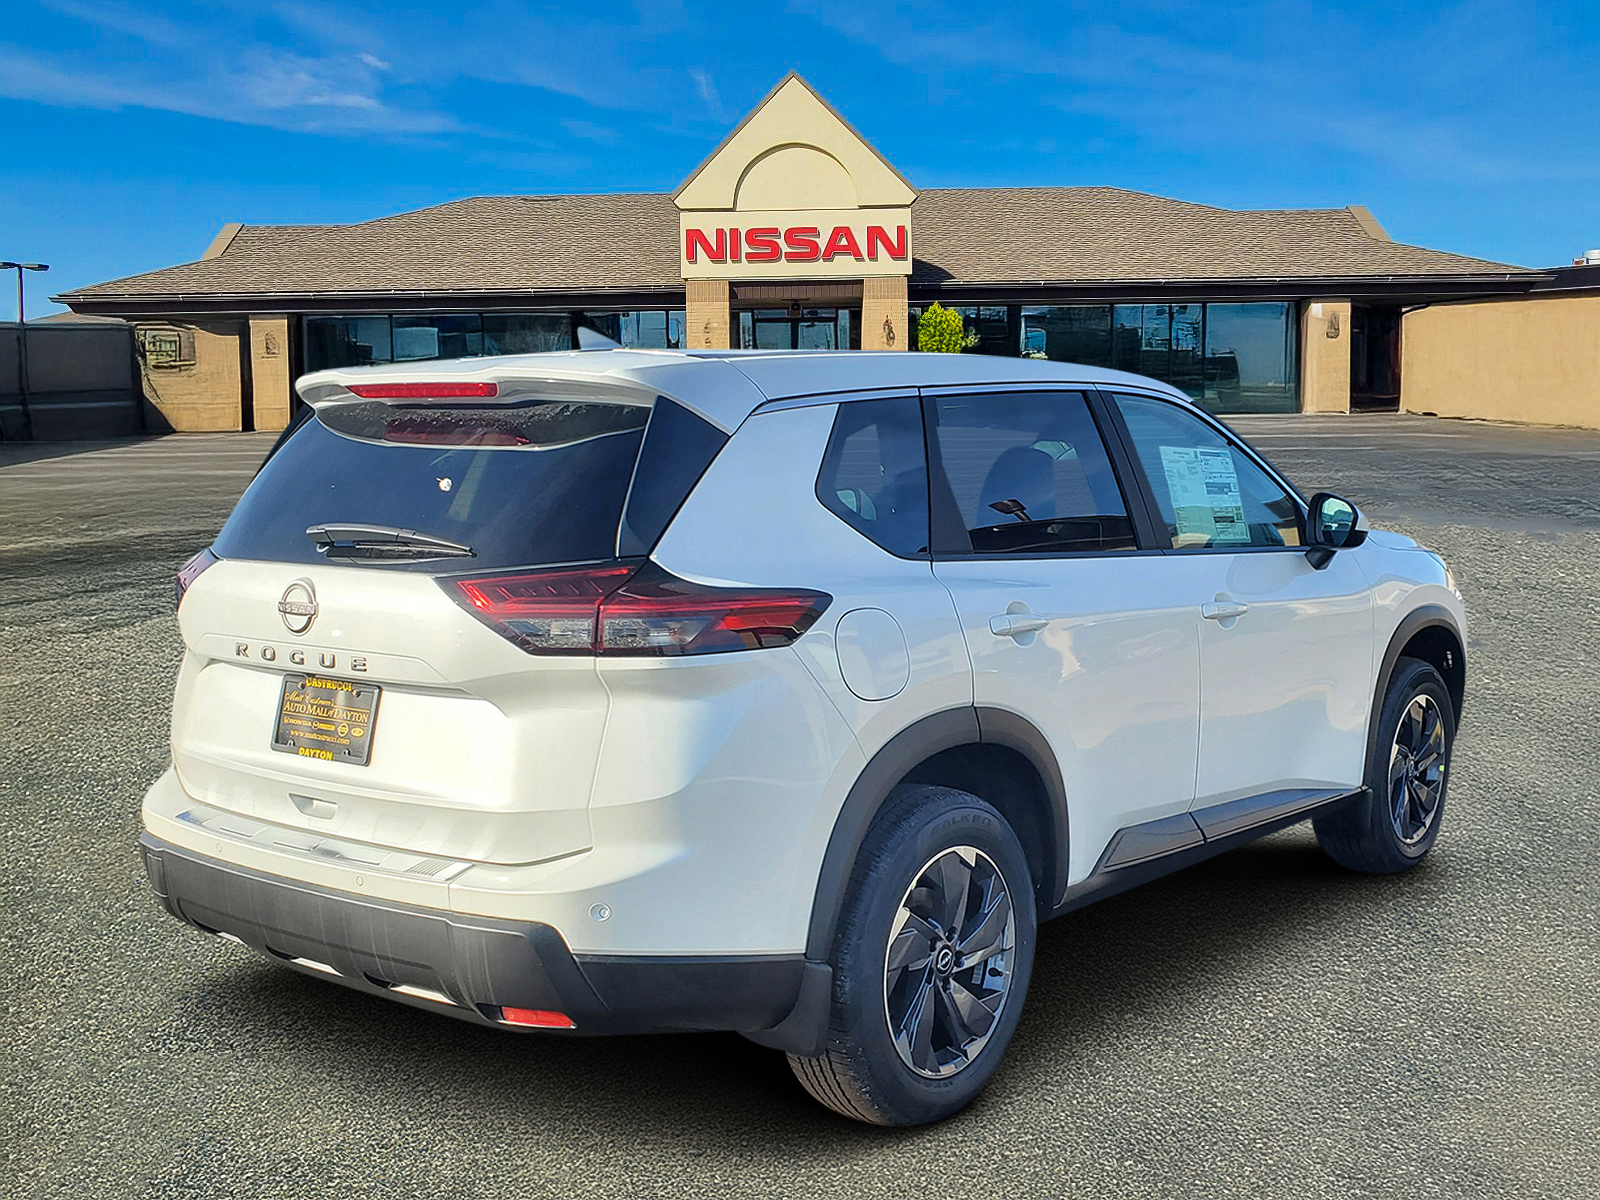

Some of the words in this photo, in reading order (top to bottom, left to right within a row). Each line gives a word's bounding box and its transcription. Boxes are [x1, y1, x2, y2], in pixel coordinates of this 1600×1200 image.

[685, 225, 908, 264] NISSAN
[235, 642, 368, 672] ROGUE
[305, 677, 352, 692] CASTRUCCI
[298, 747, 334, 761] DAYTON
